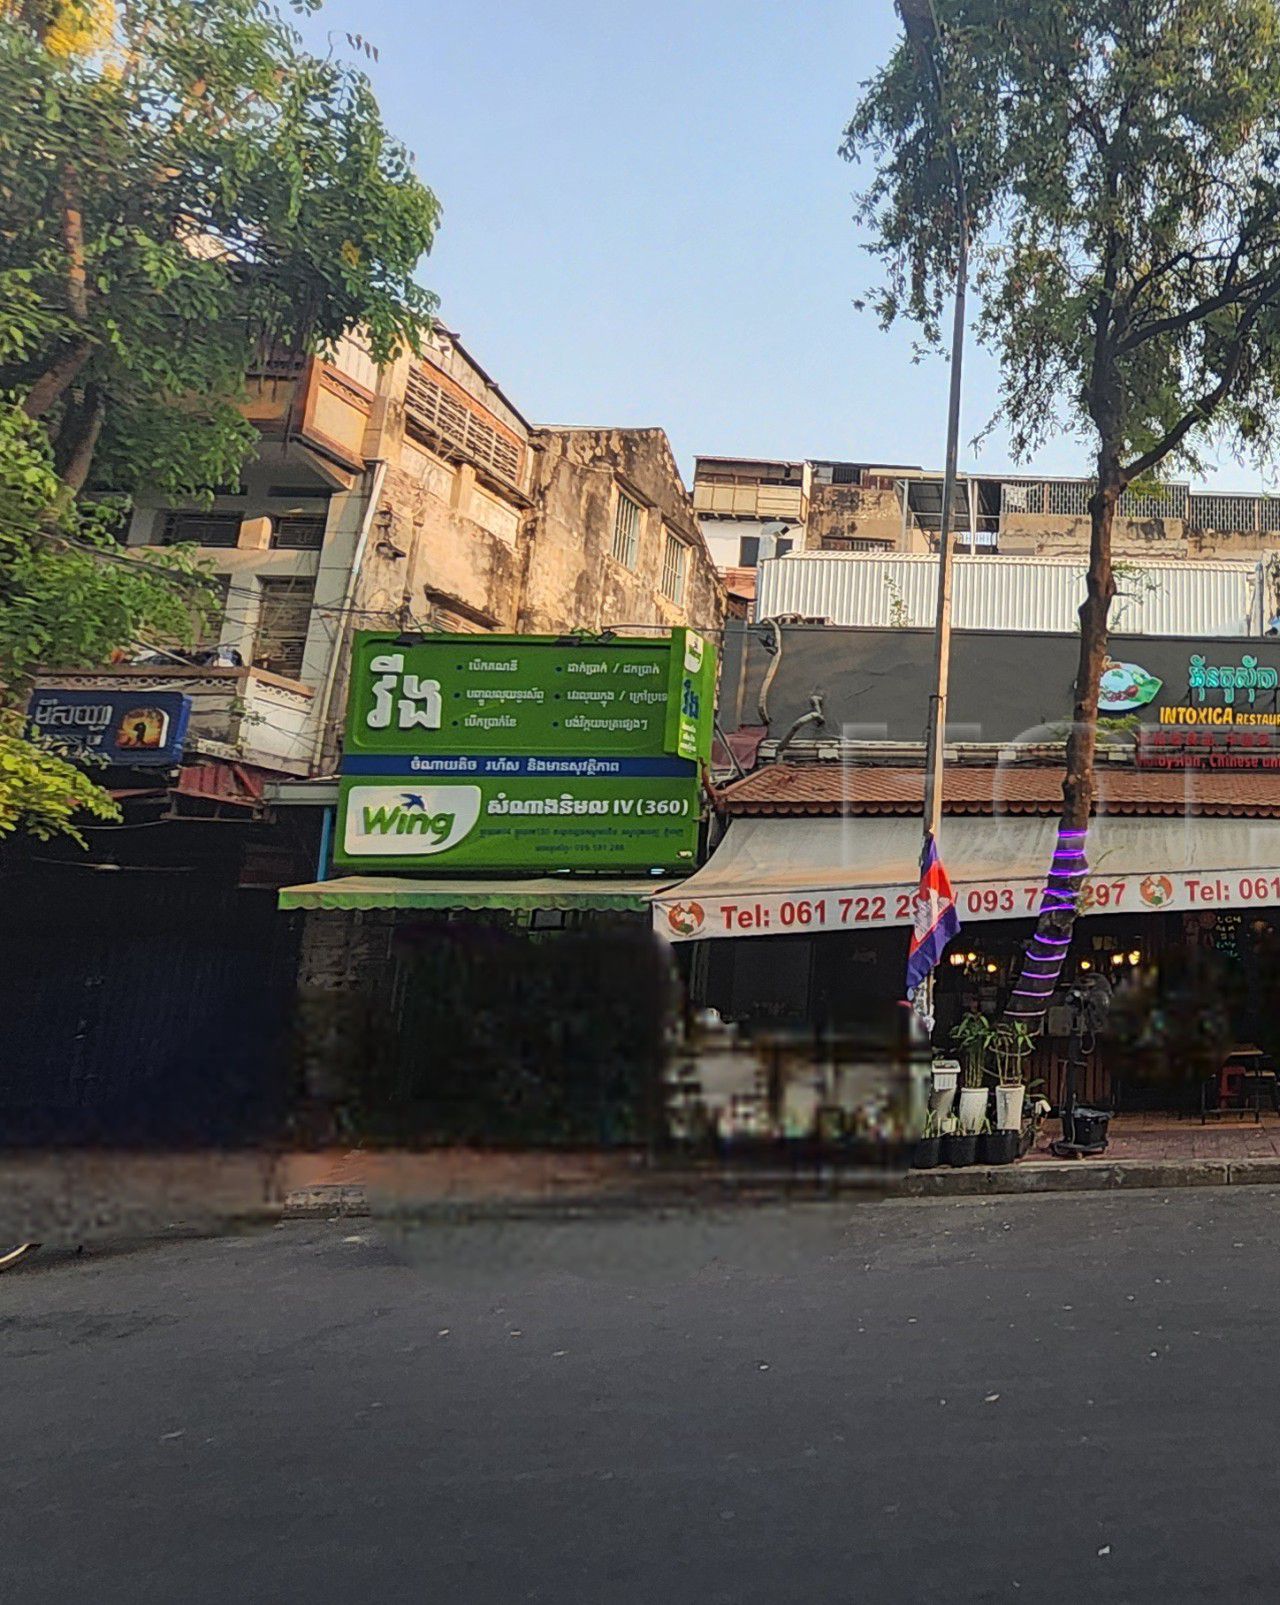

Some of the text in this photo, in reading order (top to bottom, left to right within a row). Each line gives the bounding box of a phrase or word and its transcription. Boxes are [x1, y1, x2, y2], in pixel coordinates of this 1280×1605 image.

[367, 654, 443, 729] វីង
[1160, 707, 1233, 725] INTOXICA
[1209, 753, 1259, 768] Chinese
[613, 800, 636, 814] IV
[636, 799, 689, 816] (360)
[363, 806, 456, 845] Wing
[1184, 879, 1230, 902] Tel:
[1239, 877, 1280, 900] 061
[720, 904, 770, 929] Tel:
[780, 900, 826, 926] 061
[838, 896, 887, 923] 722
[967, 889, 1014, 913] 093
